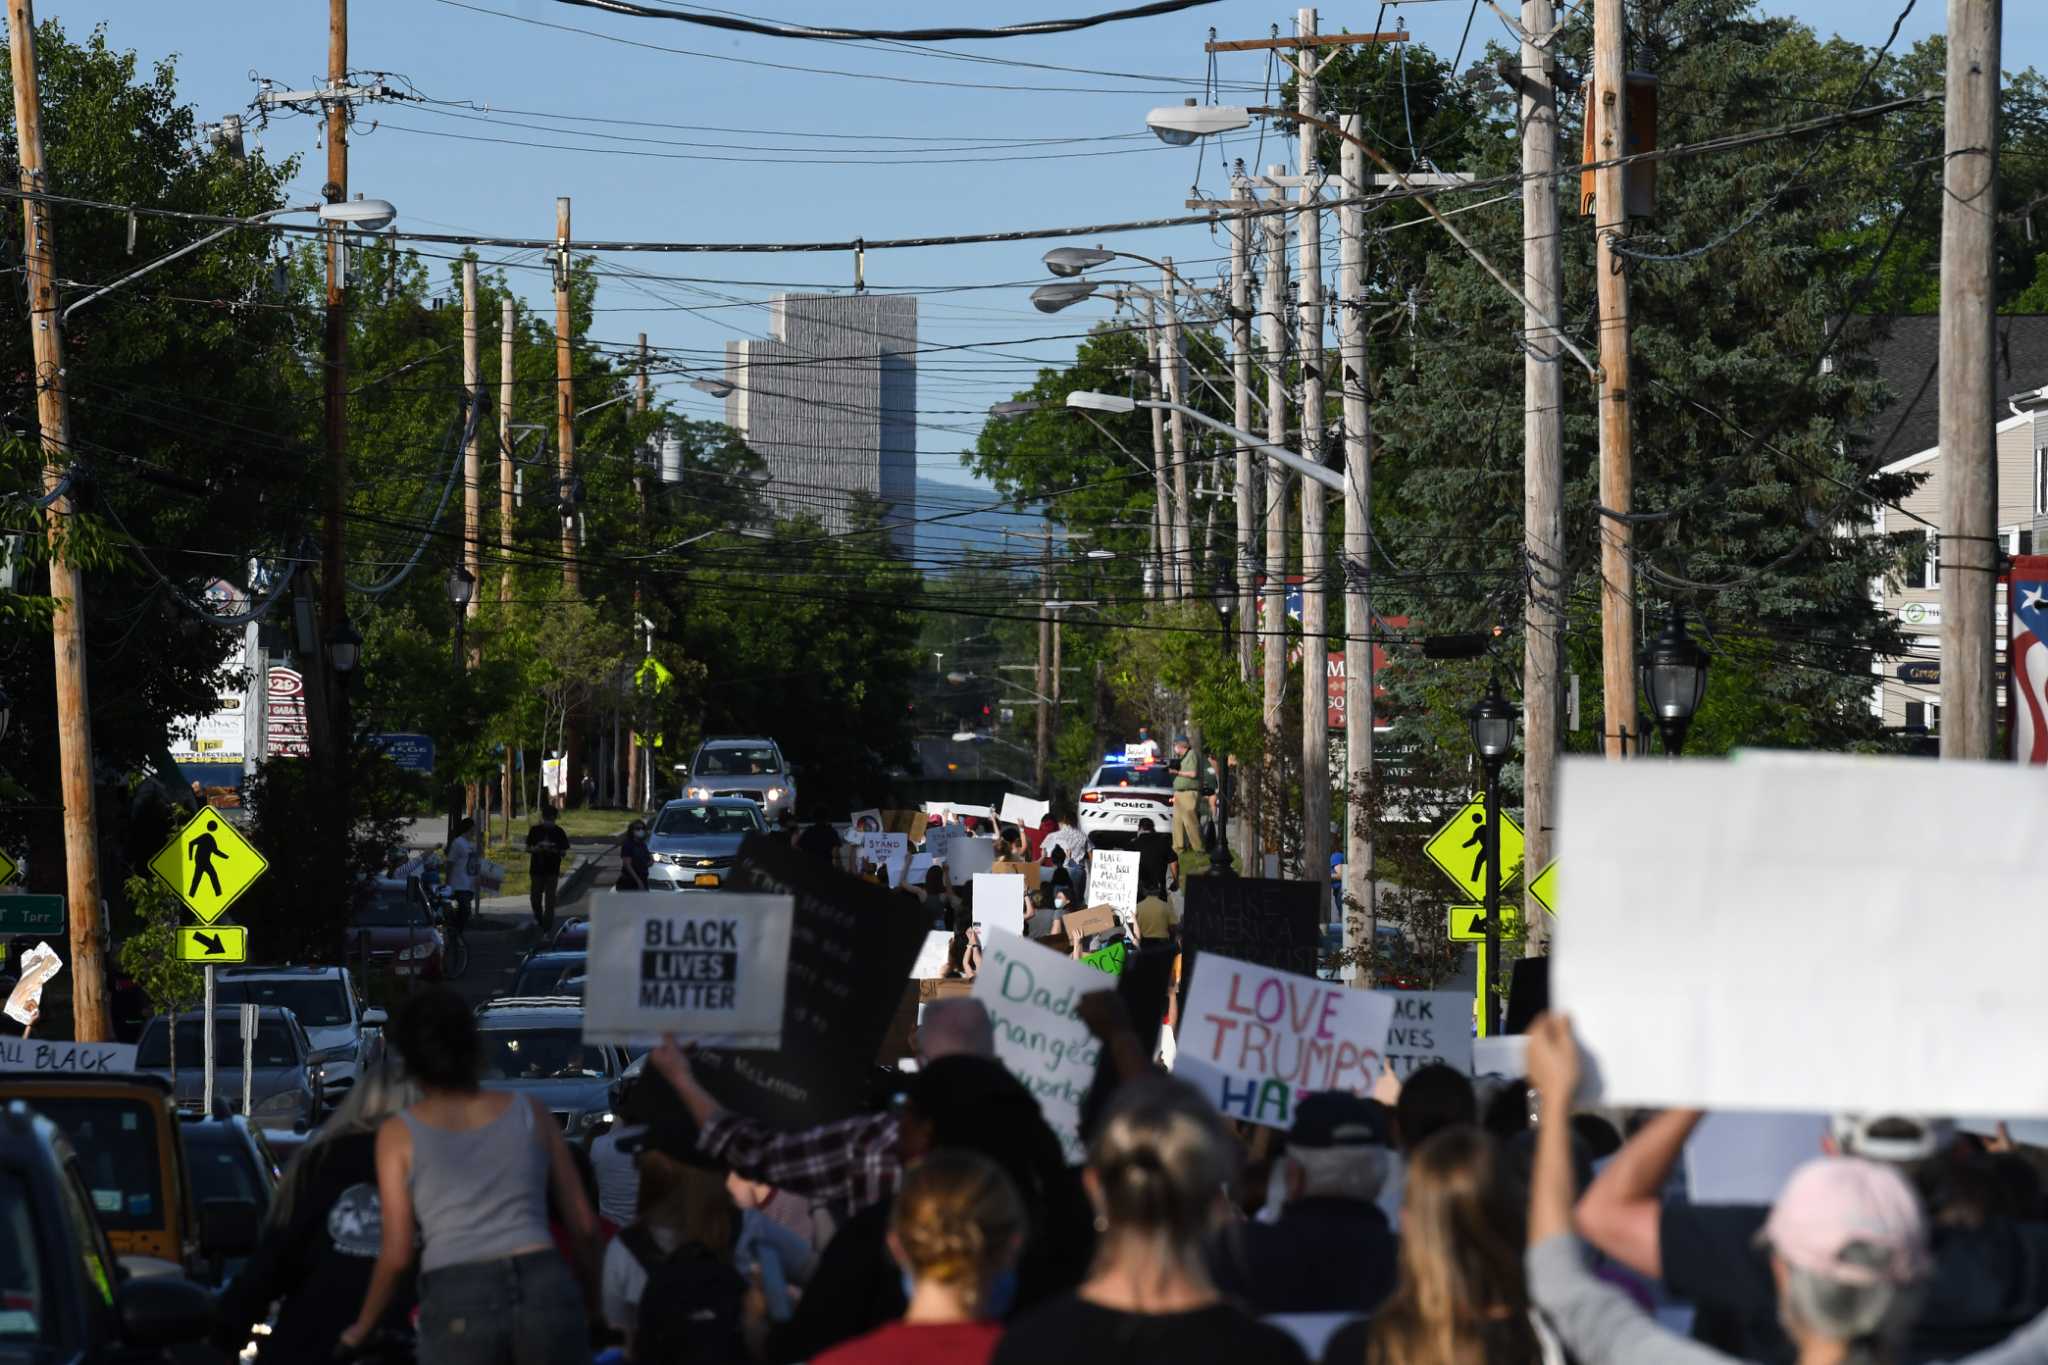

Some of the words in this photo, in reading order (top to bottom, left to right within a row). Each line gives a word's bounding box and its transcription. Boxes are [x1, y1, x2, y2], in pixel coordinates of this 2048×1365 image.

[1113, 801, 1155, 809] POLICE
[869, 840, 900, 849] STAND
[645, 919, 738, 948] BLACK
[655, 954, 724, 980] LIVES
[639, 984, 736, 1010] MATTER
[1227, 973, 1344, 1040] LOVE
[1393, 999, 1434, 1021] ACK
[1387, 1028, 1435, 1049] IVES
[35, 1044, 117, 1072] BLACK
[1204, 1014, 1379, 1092] TRUMPS
[1219, 1074, 1309, 1121] HA
